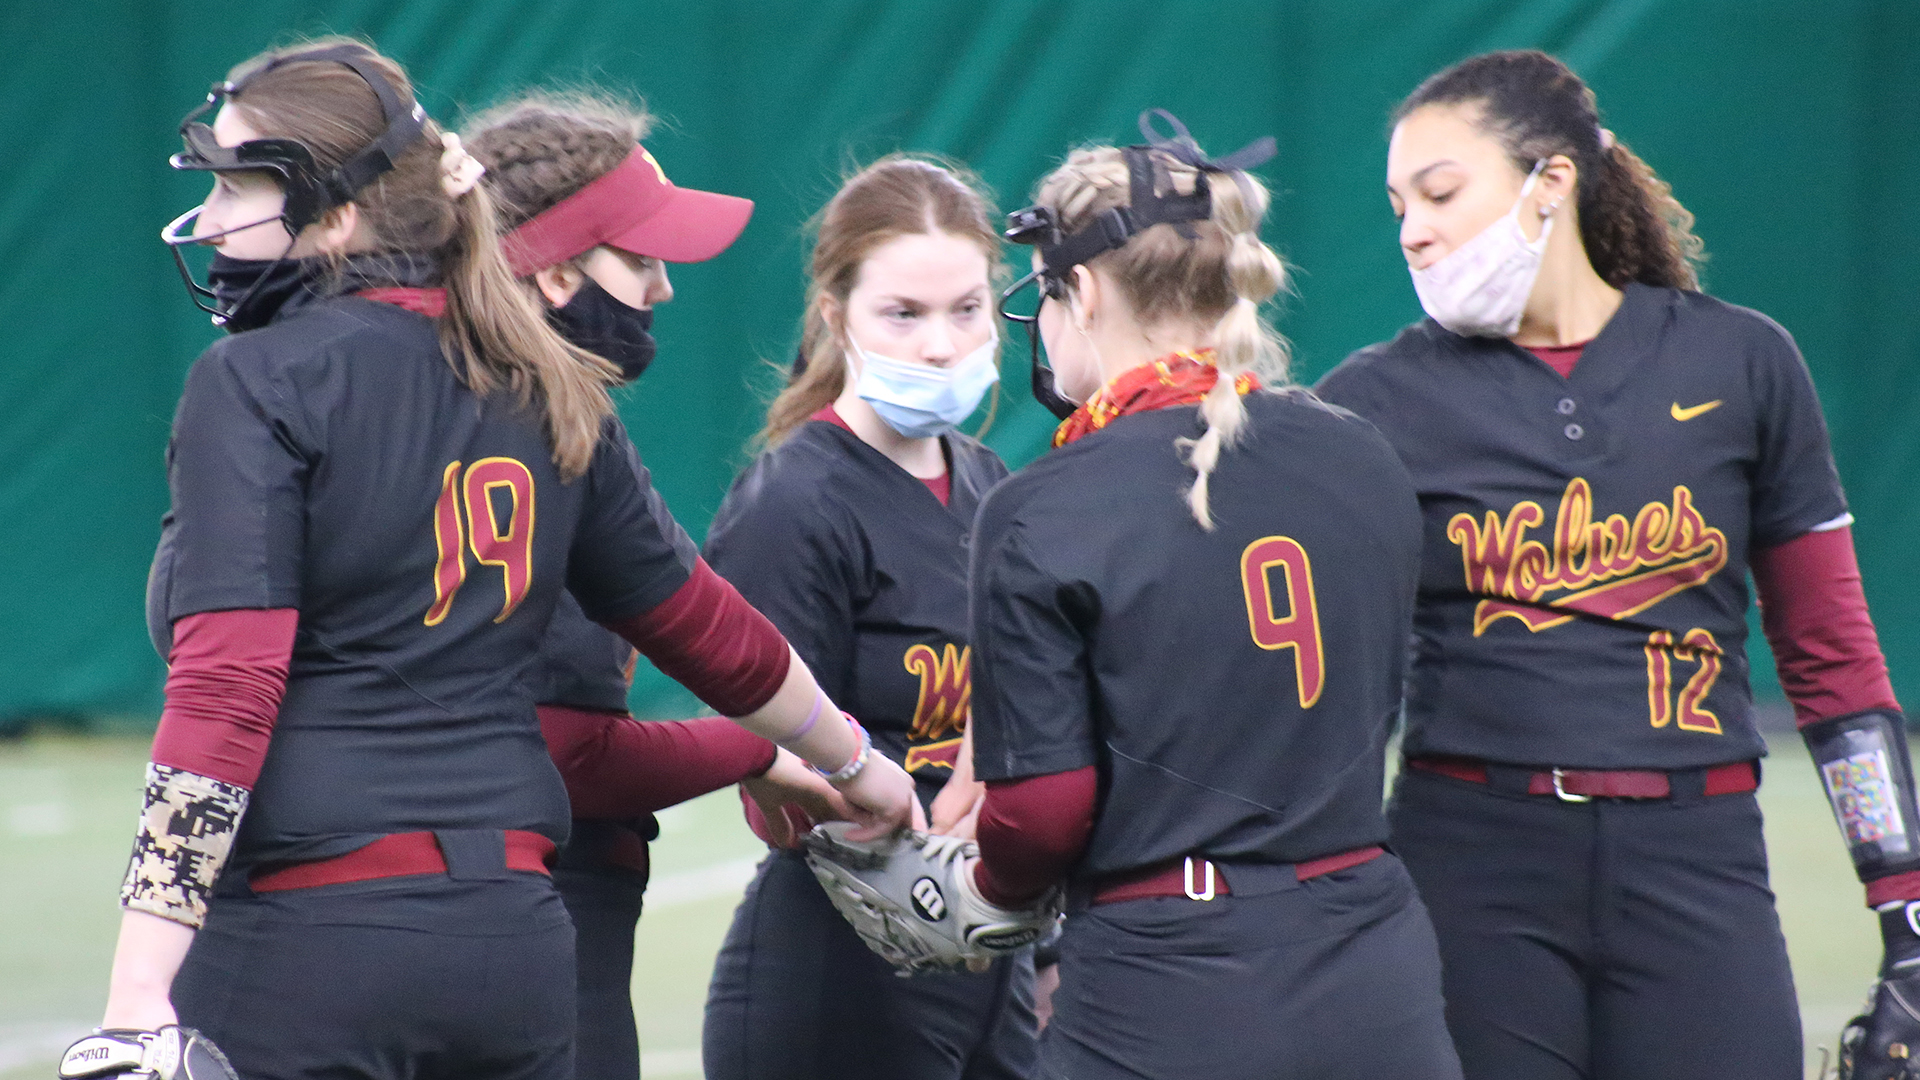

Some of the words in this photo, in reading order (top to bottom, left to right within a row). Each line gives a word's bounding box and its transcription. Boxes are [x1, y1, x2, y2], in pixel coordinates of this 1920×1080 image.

[424, 456, 536, 626] 19
[1447, 477, 1714, 602] Wolves
[1240, 535, 1325, 709] 9
[1644, 627, 1724, 735] 12
